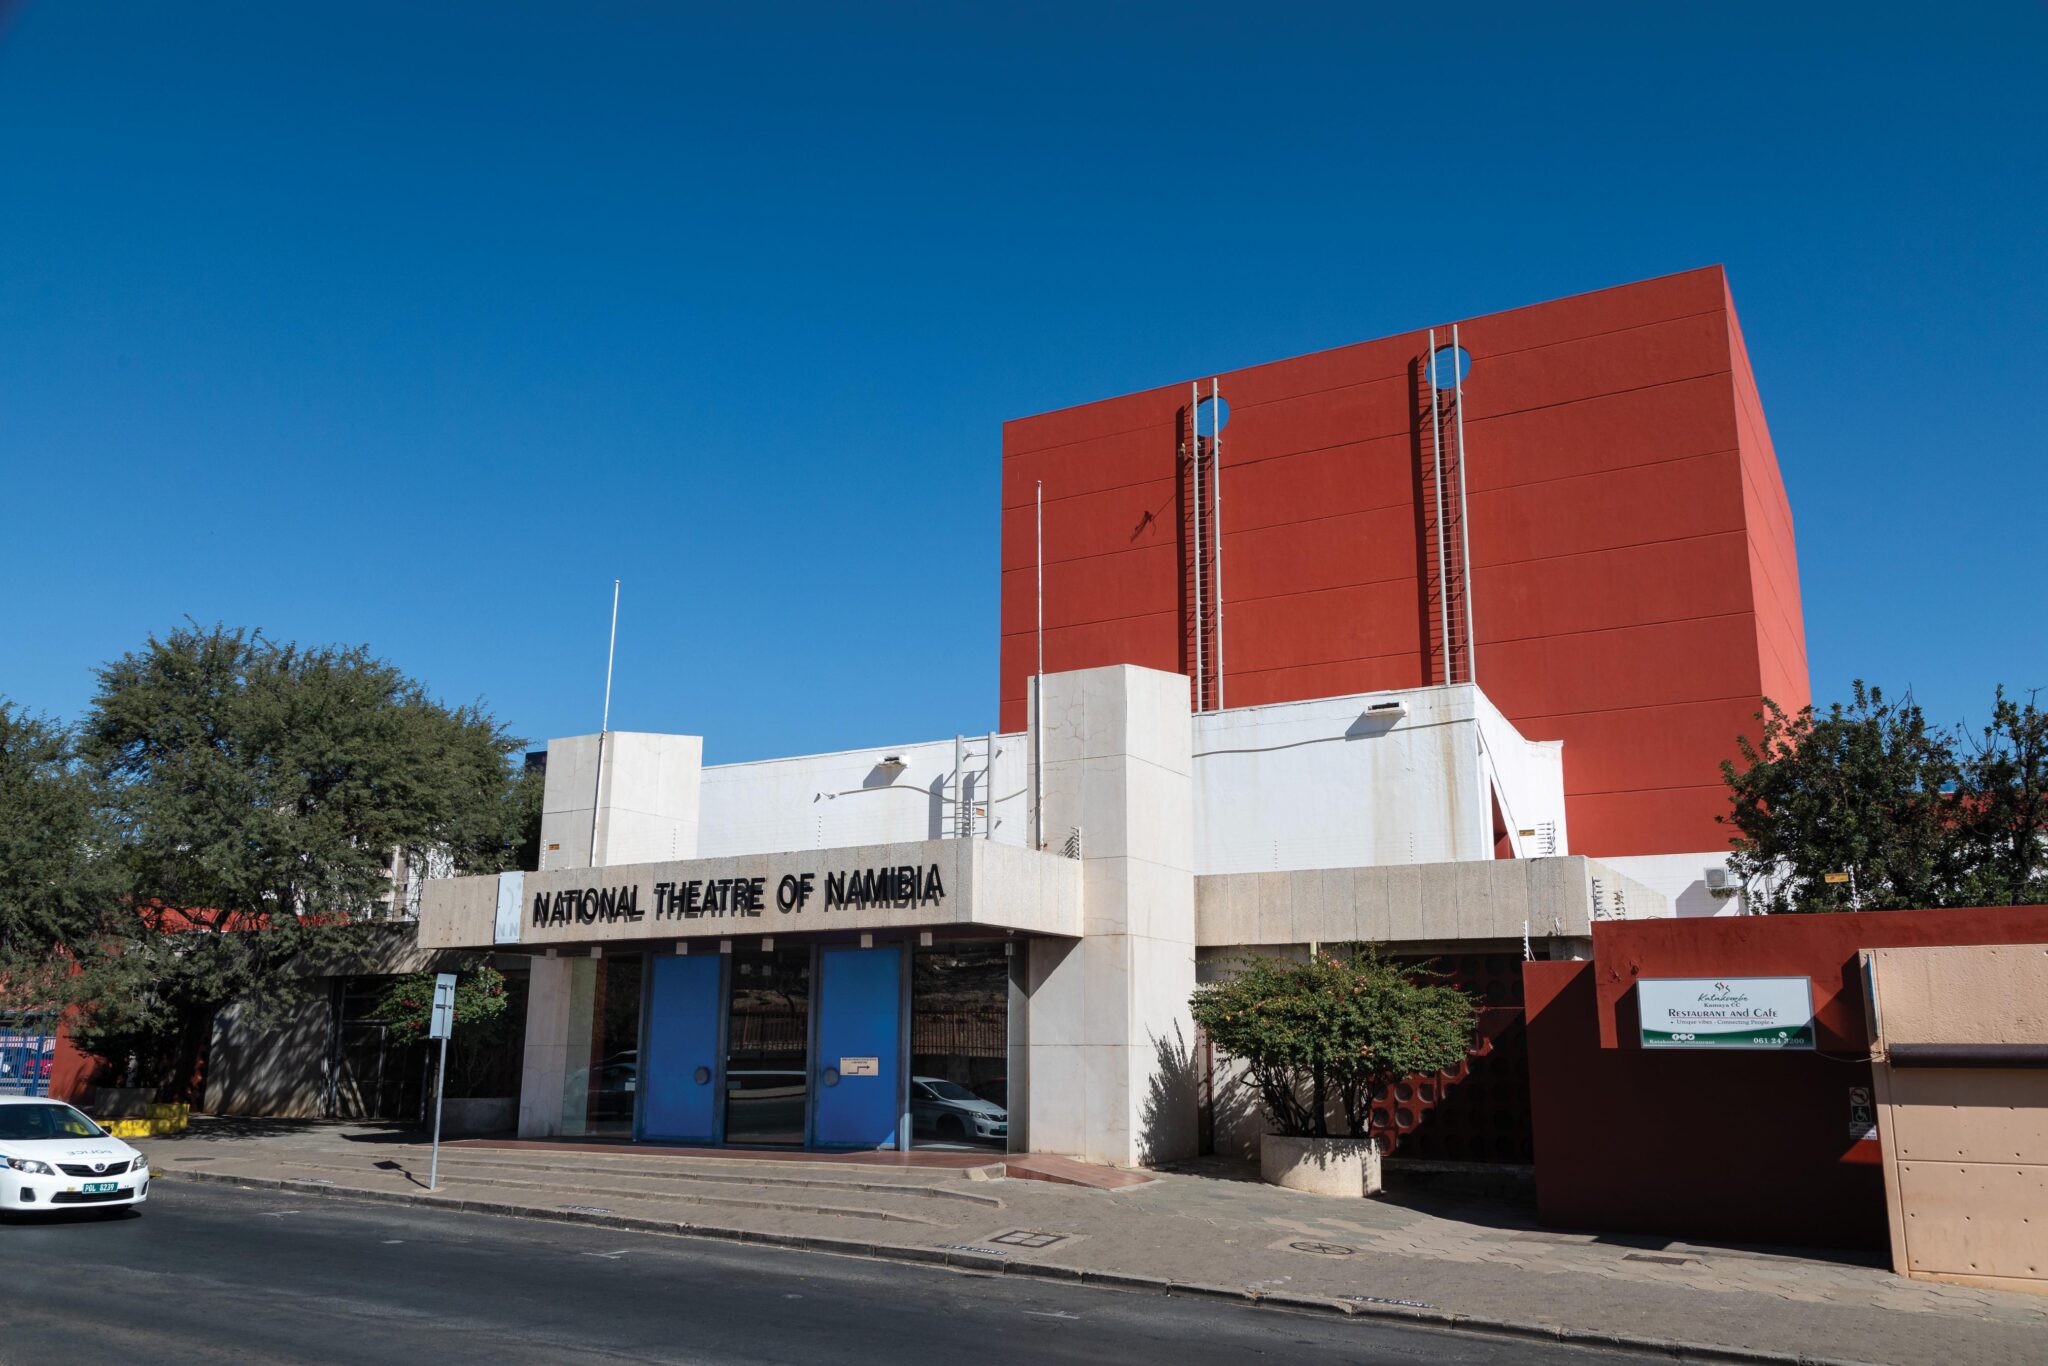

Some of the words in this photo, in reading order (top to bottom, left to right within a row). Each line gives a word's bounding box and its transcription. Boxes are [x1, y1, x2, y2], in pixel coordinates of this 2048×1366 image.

[534, 884, 645, 925] NATIONAL
[654, 877, 766, 917] THEATRE
[777, 873, 816, 911] OF
[826, 863, 946, 908] NAMIBIA
[84, 1184, 97, 1192] POL
